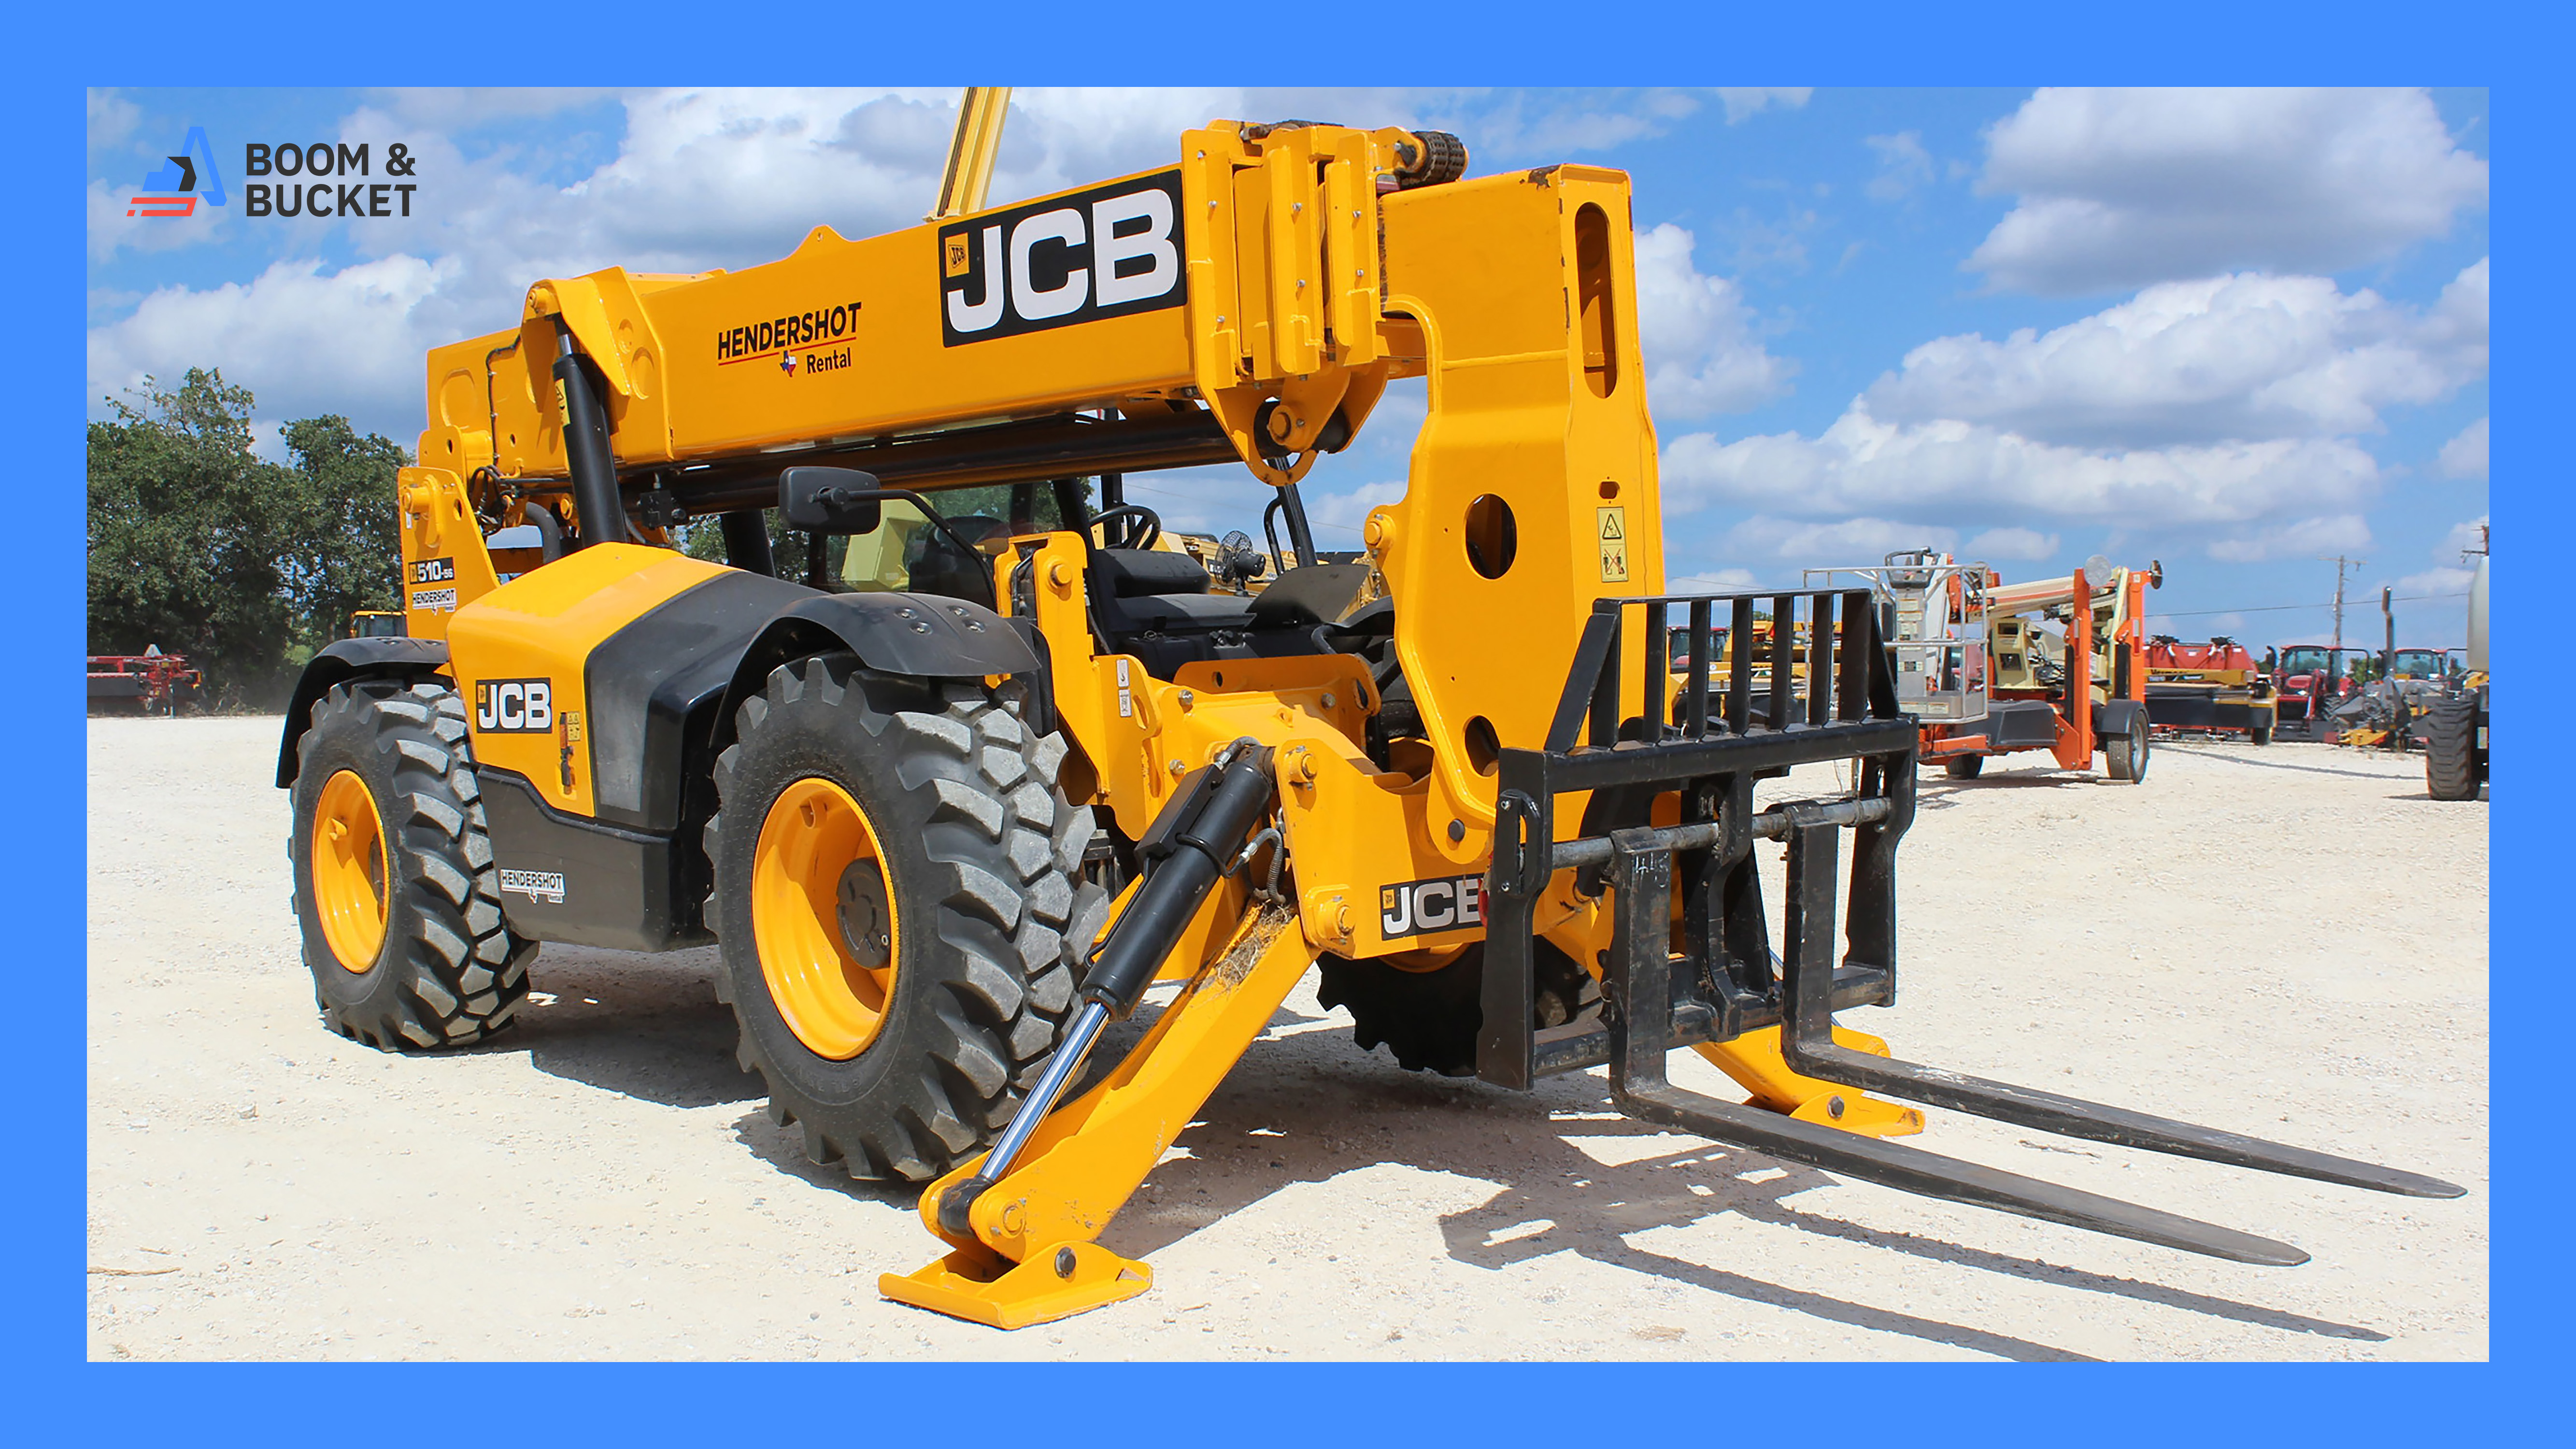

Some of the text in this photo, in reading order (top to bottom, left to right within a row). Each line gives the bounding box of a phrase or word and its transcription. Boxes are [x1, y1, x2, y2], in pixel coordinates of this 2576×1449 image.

[948, 189, 1178, 332] JCB
[718, 302, 861, 359] HENDERSHOT
[807, 347, 851, 373] Rental
[413, 590, 455, 604] HENDERSHOT
[478, 683, 551, 728] JCB
[502, 871, 562, 889] HENDERSHOT
